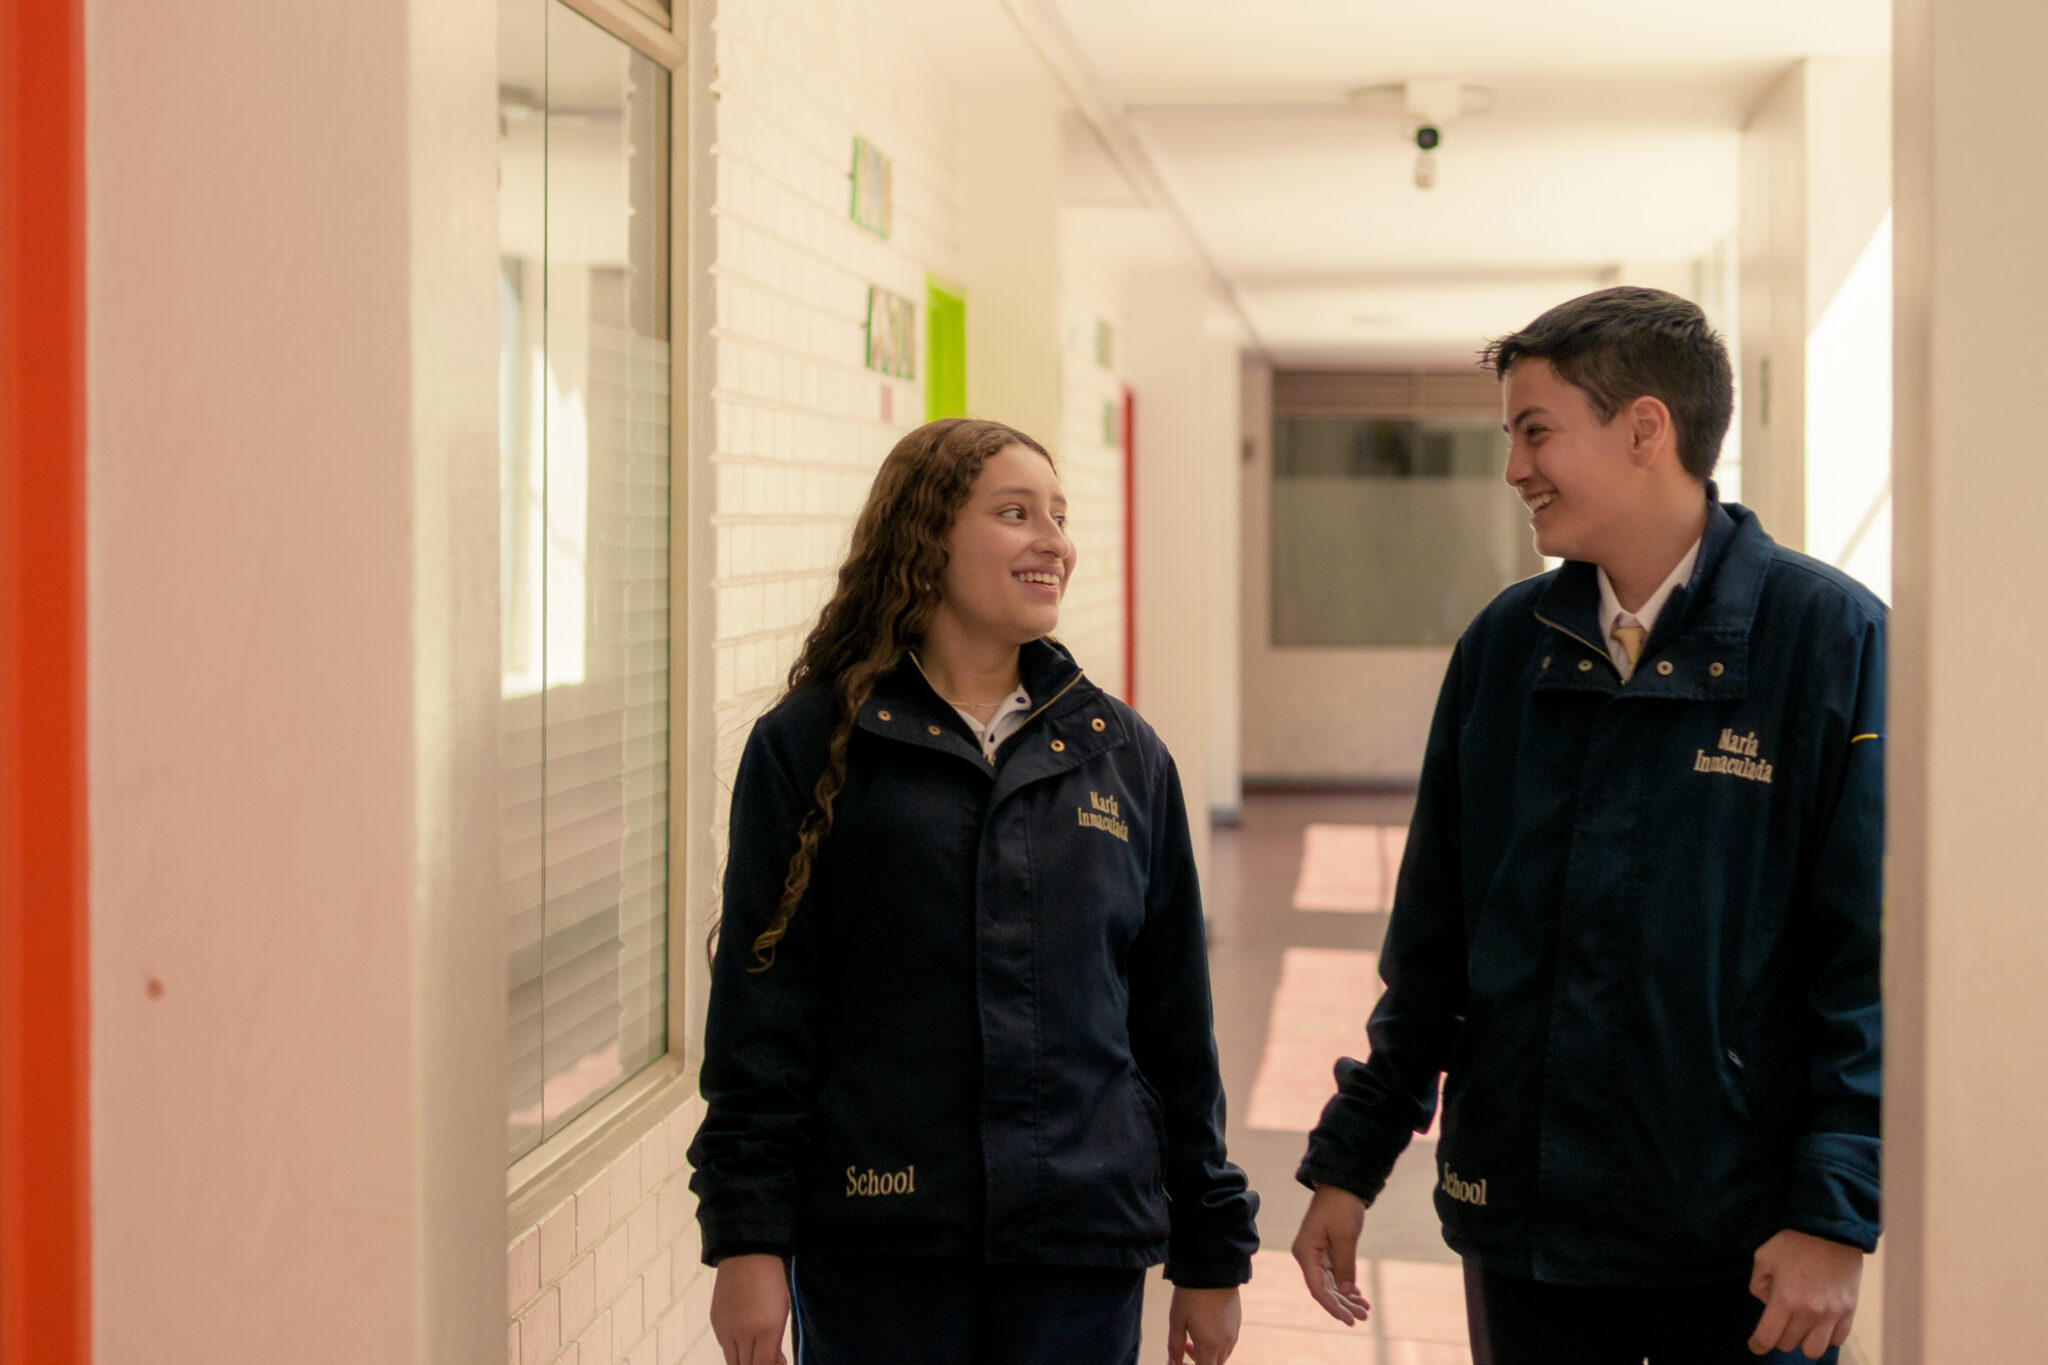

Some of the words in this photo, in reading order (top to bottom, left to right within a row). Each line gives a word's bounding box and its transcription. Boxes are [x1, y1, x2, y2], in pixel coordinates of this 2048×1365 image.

[1718, 728, 1759, 758] María
[1693, 749, 1773, 783] Inmaculada
[1077, 807, 1129, 842] Inmaculada
[846, 1165, 915, 1197] School
